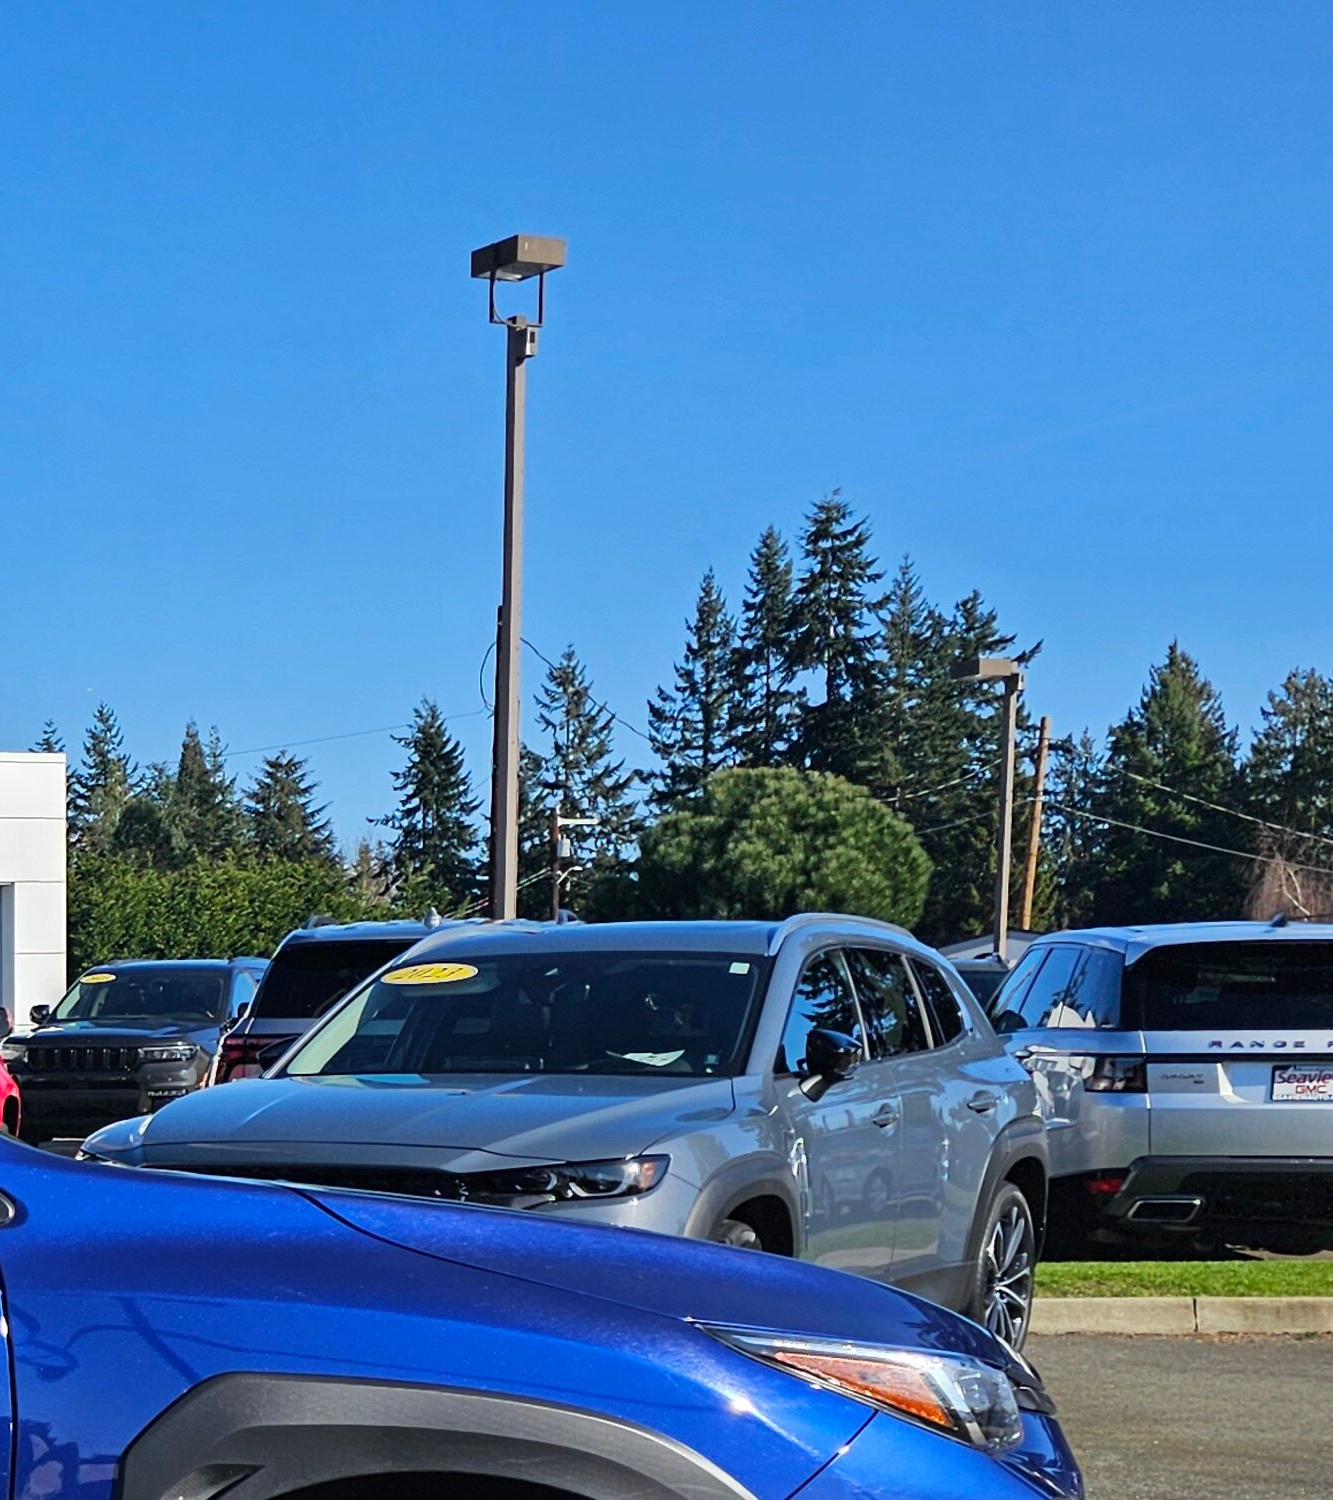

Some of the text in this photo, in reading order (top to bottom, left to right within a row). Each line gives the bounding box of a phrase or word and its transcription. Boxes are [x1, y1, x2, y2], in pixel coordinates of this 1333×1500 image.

[1207, 1040, 1306, 1049] RANGE
[1275, 1070, 1333, 1084] Seavie
[1296, 1085, 1328, 1094] GMC
